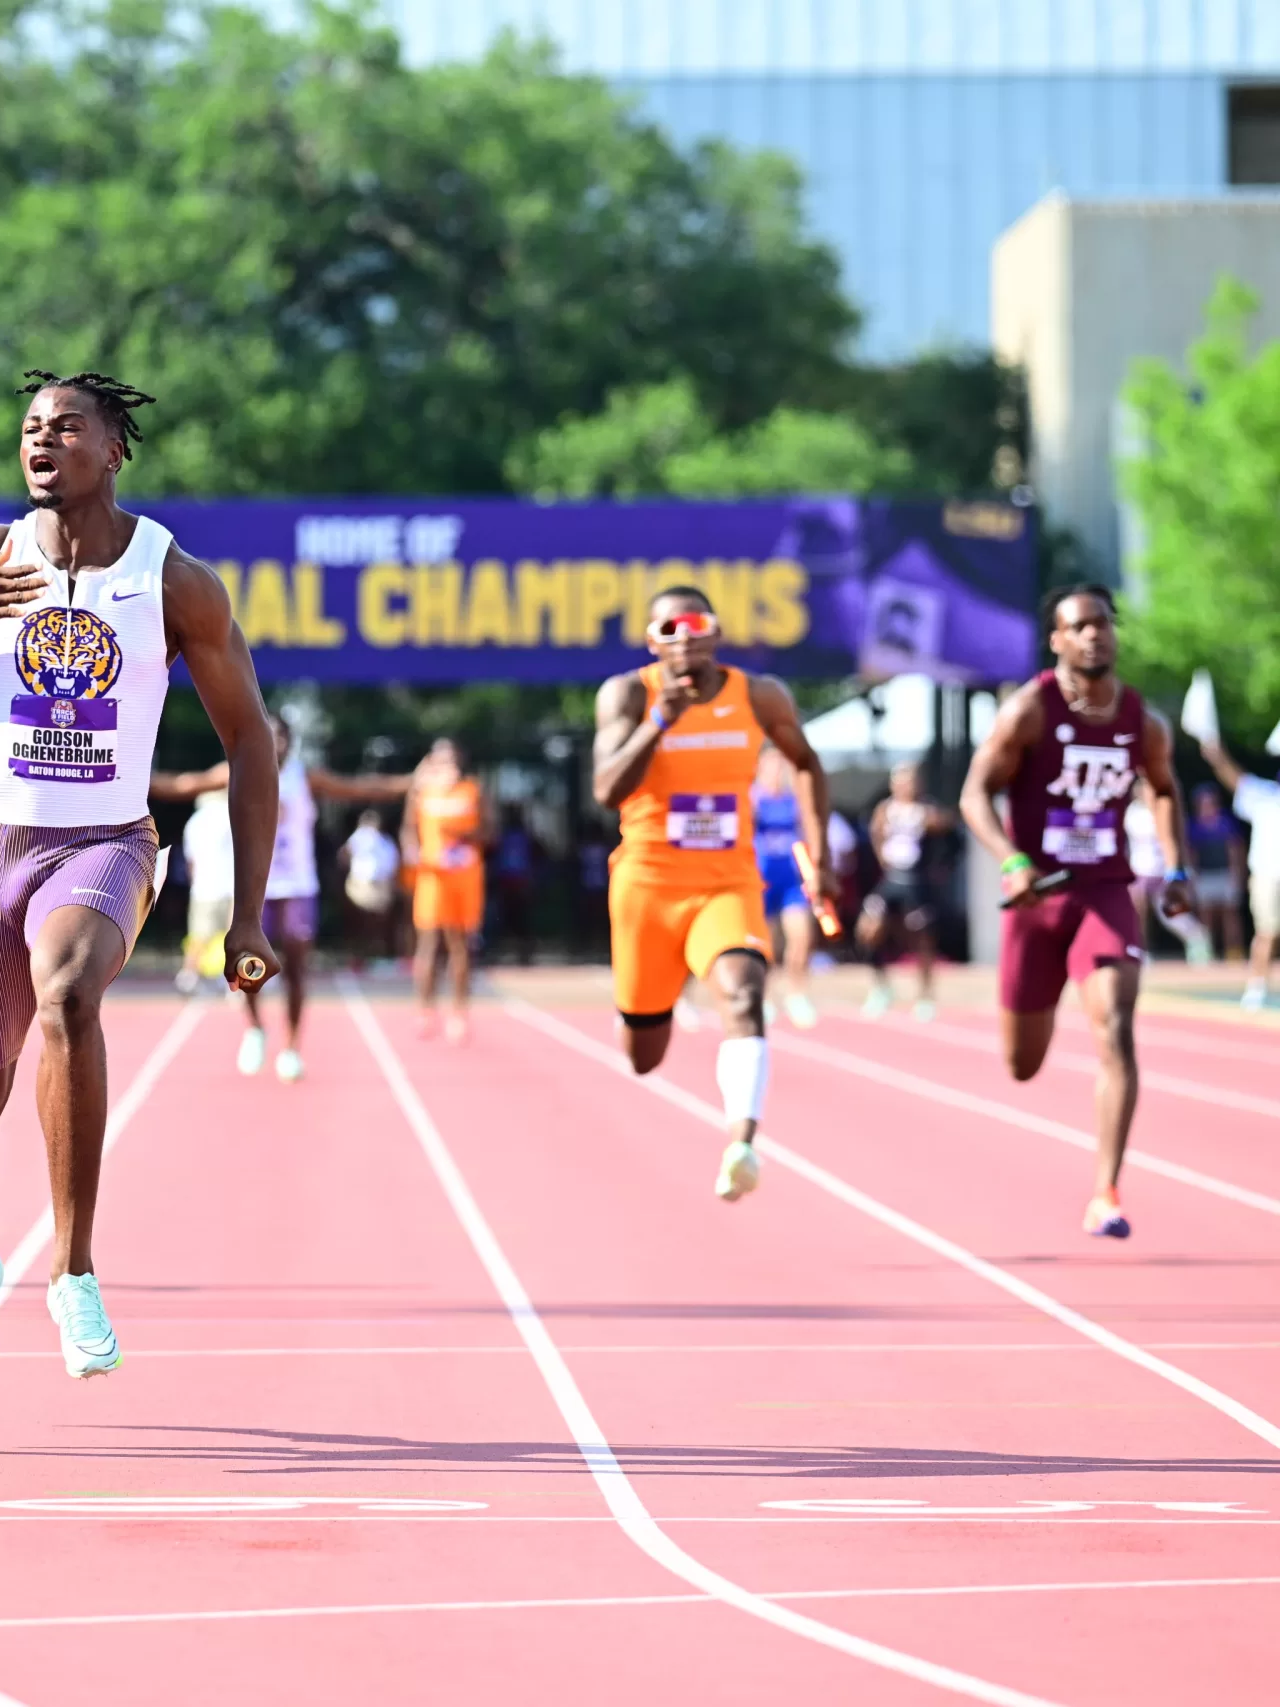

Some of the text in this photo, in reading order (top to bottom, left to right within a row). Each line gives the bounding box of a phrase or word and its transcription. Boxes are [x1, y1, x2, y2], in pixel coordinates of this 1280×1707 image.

[296, 515, 464, 565] HOME OF
[33, 729, 93, 748] GODSON
[12, 742, 114, 764] OGHENEBRUME
[28, 765, 94, 779] BATON ROUGE, LA
